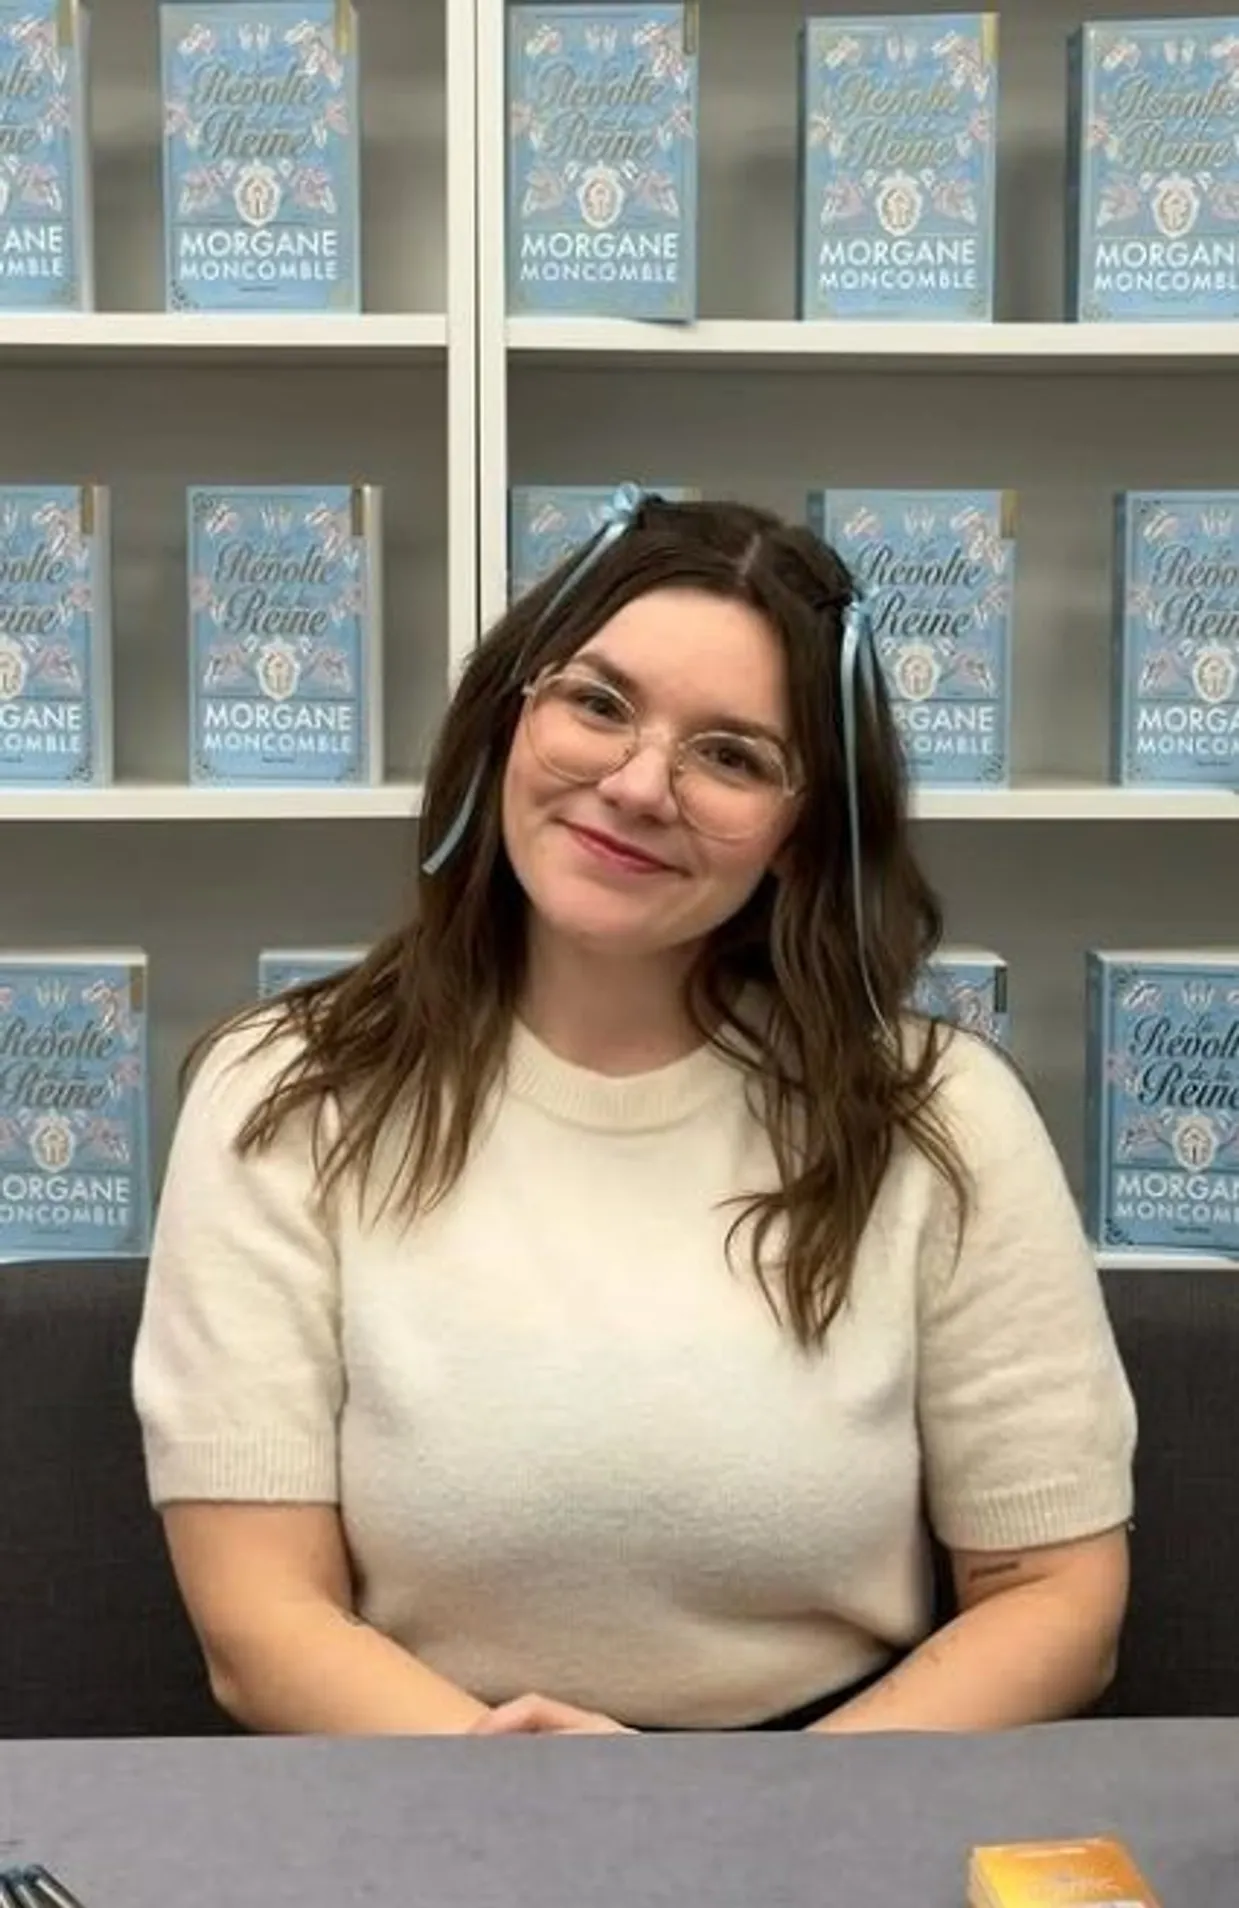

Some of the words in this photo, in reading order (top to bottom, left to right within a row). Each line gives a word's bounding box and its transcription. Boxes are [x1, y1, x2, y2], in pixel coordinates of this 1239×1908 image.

[179, 229, 338, 257] MORGANE
[520, 232, 679, 259] MORGANE
[819, 239, 976, 266] MORGANE
[1095, 242, 1239, 269] MORGAN
[179, 259, 338, 281] MONCOMBLE
[520, 262, 677, 282] MONCOMBLE
[819, 268, 976, 290] MONCOMBLE
[204, 704, 352, 730] MORGANE
[203, 733, 352, 753] MONCOMBLE
